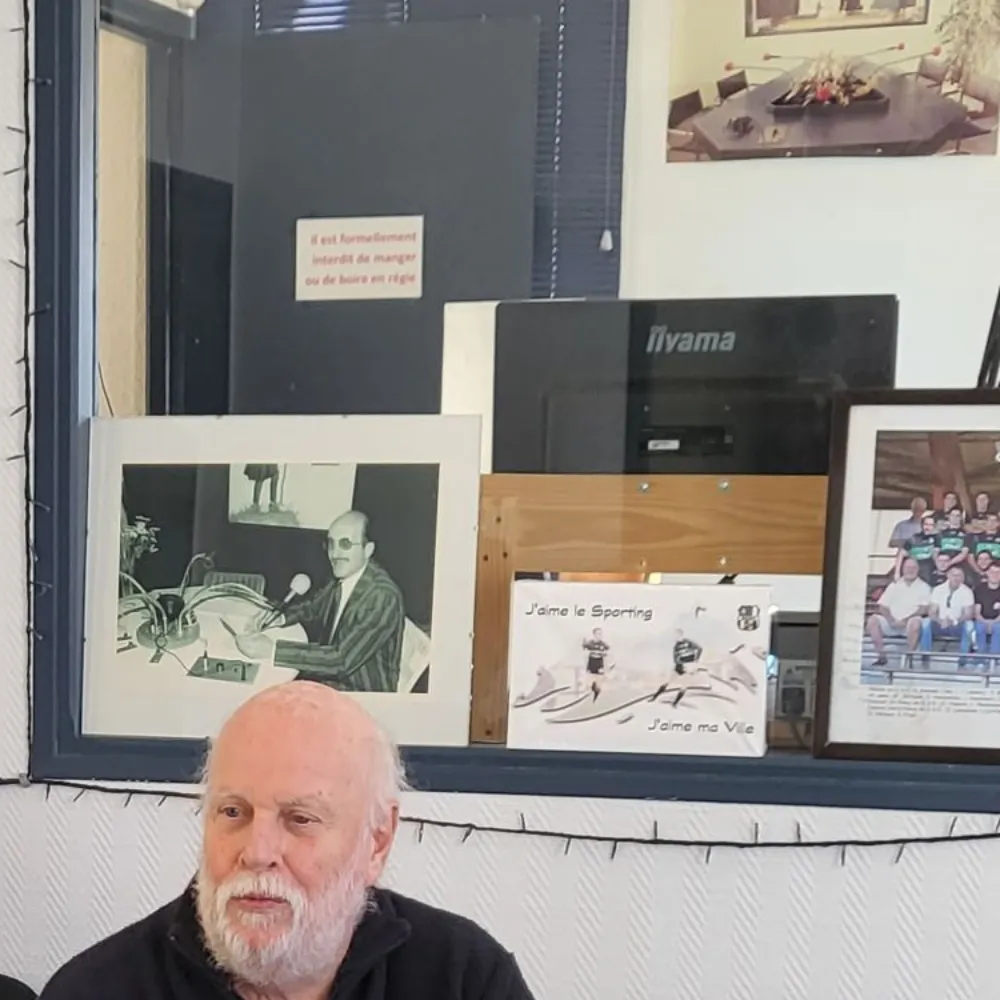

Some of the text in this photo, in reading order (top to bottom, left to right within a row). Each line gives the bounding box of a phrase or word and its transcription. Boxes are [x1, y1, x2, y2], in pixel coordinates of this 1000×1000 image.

[320, 234, 337, 246] est
[340, 231, 417, 245] formellement
[312, 252, 416, 266] interdit de manger
[305, 276, 320, 287] ou
[322, 274, 335, 286] de
[339, 273, 368, 285] boire
[370, 274, 385, 284] en
[525, 601, 653, 622] J'aime le Sporting
[647, 718, 692, 732] J'aime
[698, 723, 719, 733] ma
